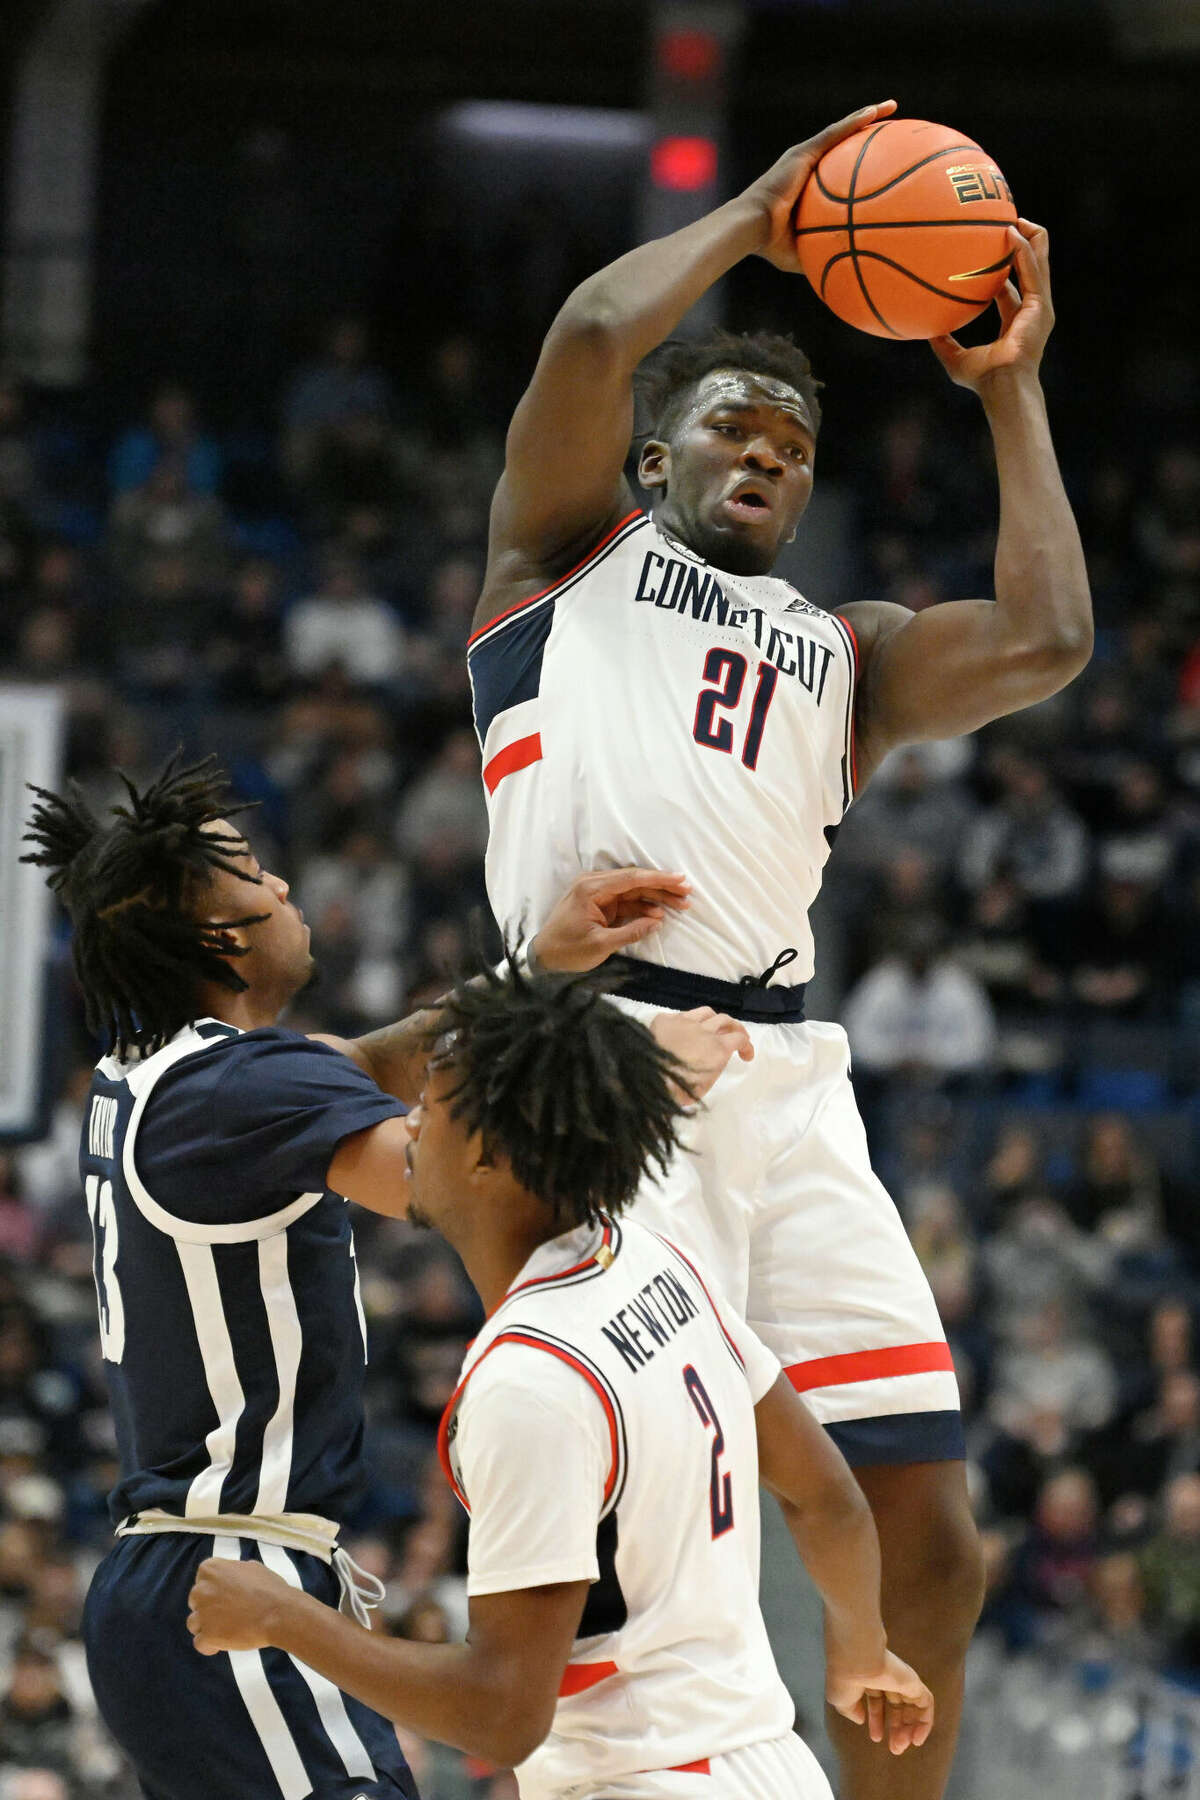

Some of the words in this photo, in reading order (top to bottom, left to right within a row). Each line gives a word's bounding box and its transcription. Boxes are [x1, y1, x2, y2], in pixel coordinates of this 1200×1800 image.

[693, 647, 779, 772] 21
[601, 1268, 700, 1374] NEWTON
[682, 1363, 734, 1542] 2
